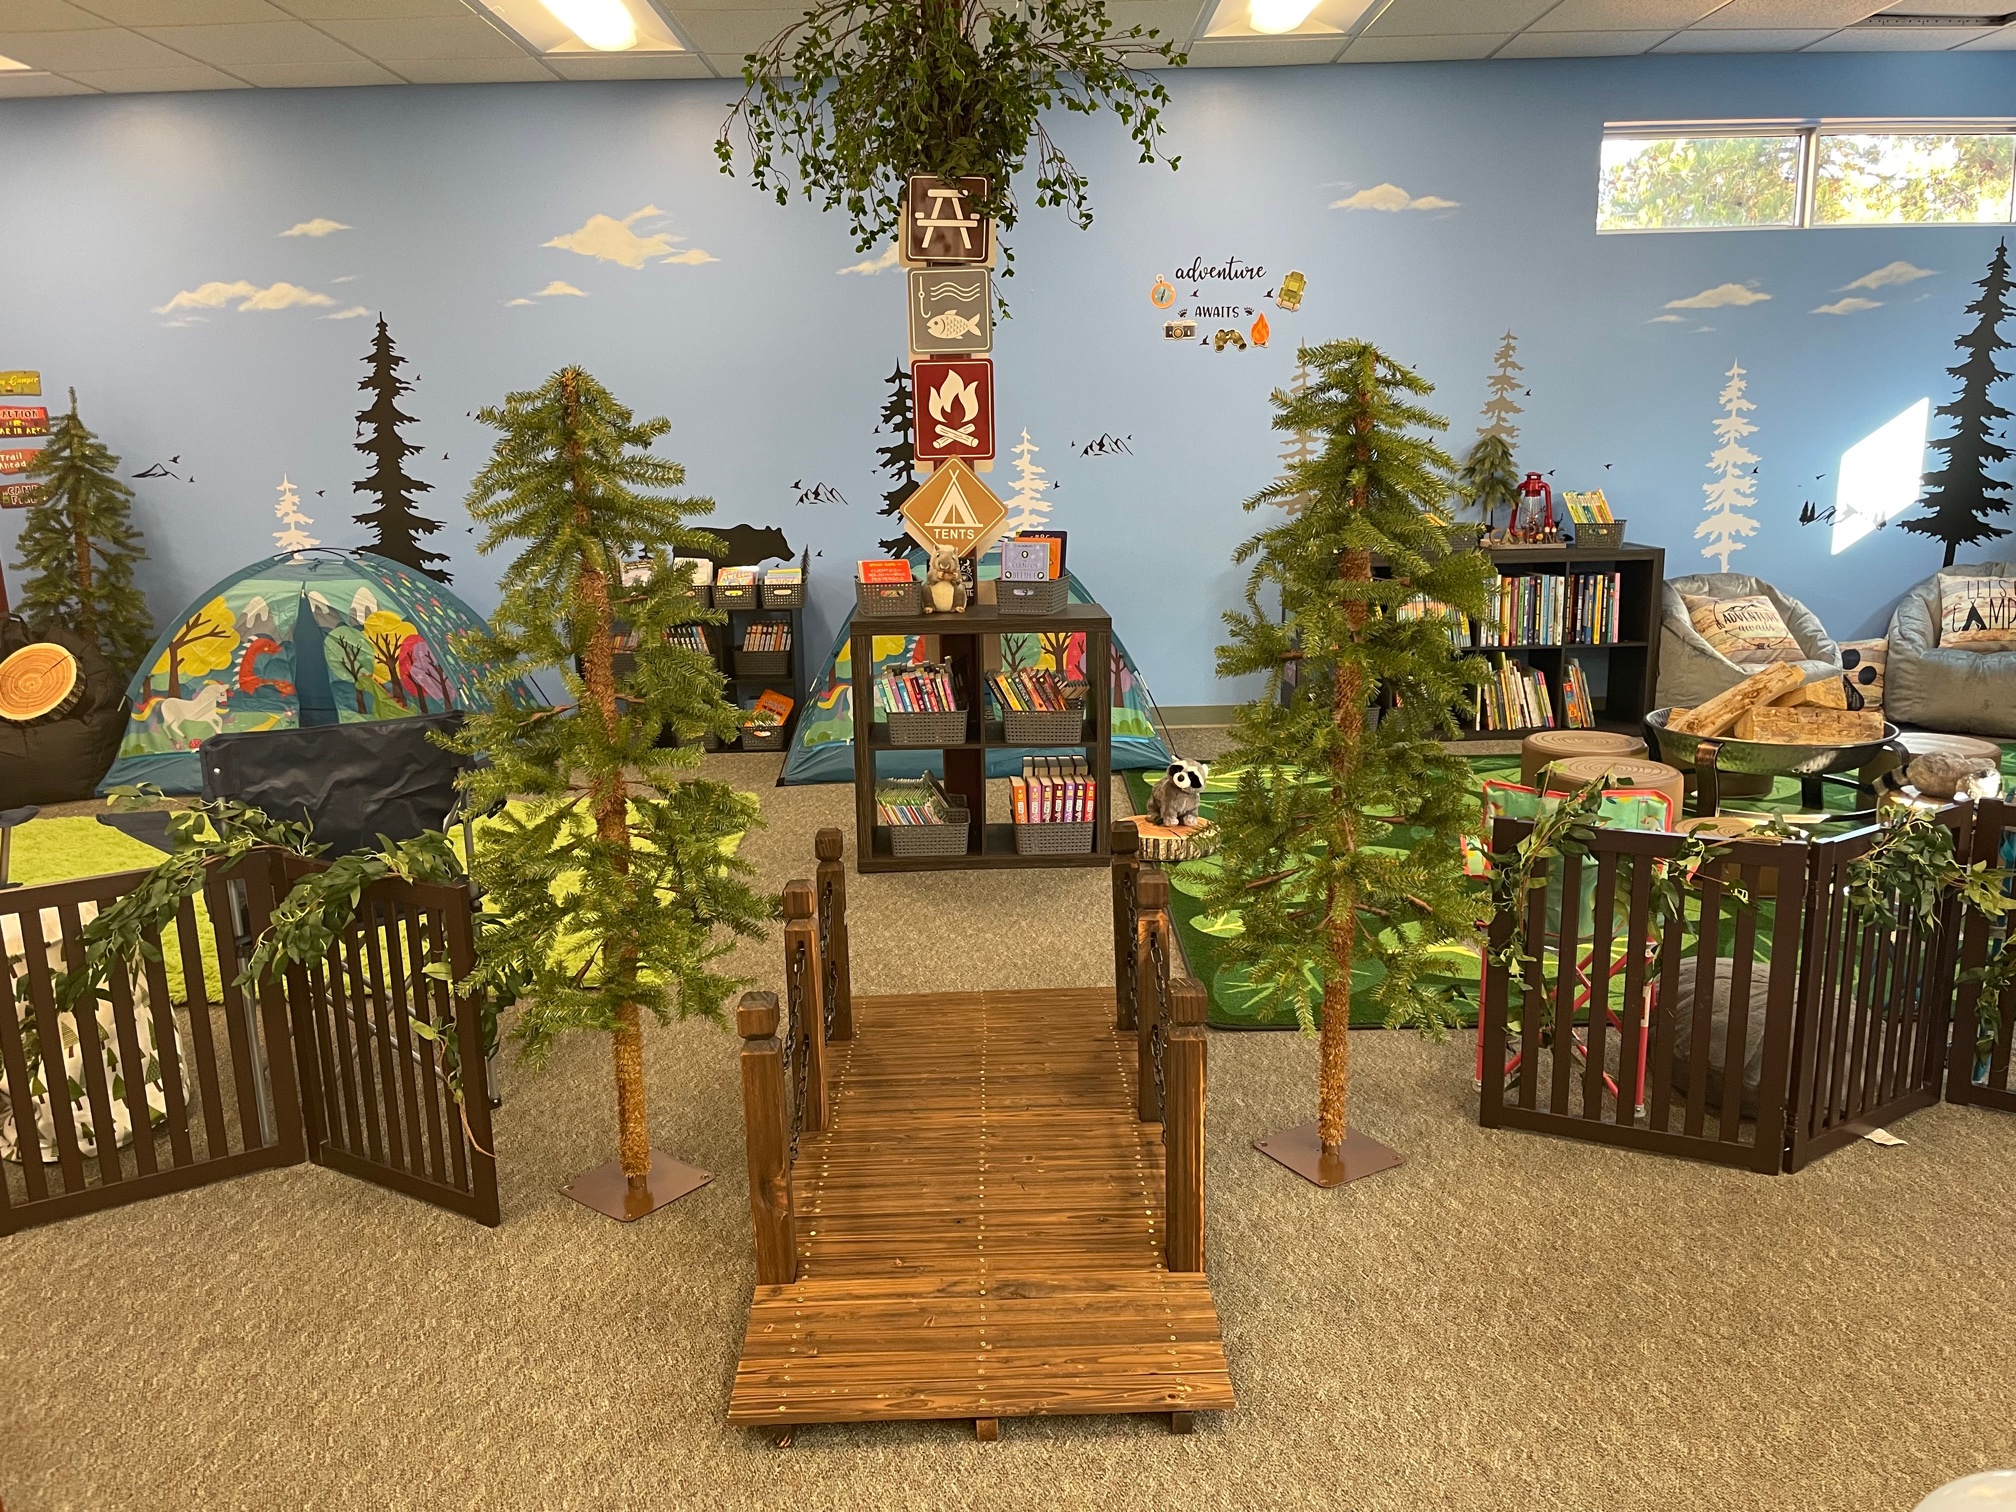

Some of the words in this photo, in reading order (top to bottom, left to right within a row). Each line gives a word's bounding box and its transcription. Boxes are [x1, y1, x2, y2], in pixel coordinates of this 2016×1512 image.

[1175, 256, 1267, 282] adventure
[1195, 306, 1239, 318] AWAITS
[1, 410, 38, 418] AUTION
[0, 452, 23, 461] Trail
[933, 528, 975, 540] TENTS
[1722, 611, 1780, 625] ADVENTURE
